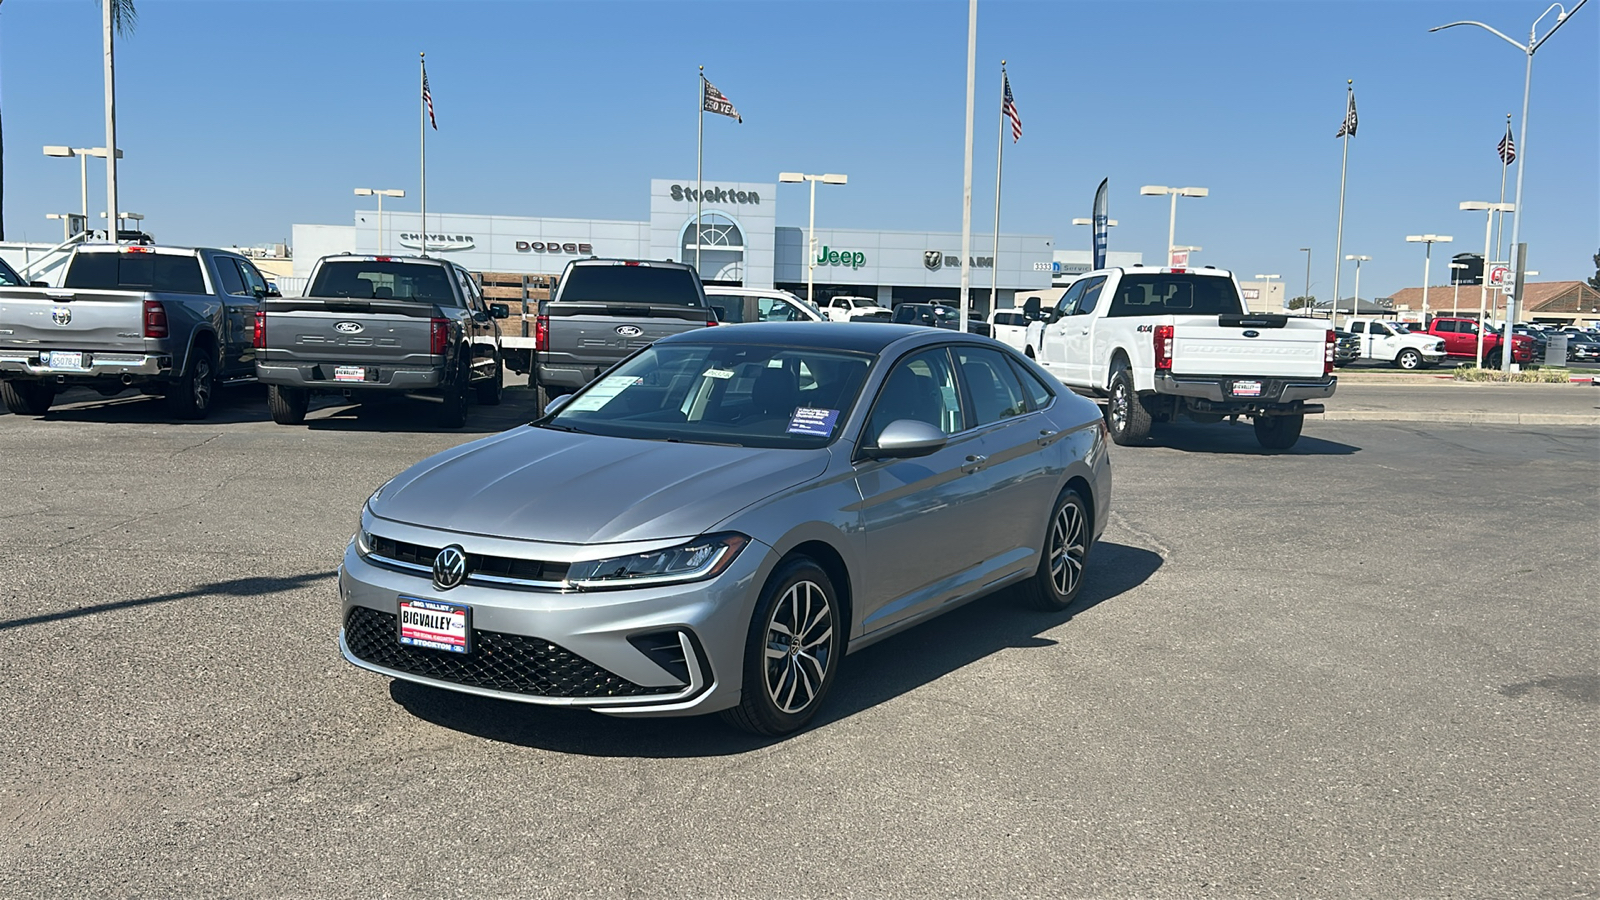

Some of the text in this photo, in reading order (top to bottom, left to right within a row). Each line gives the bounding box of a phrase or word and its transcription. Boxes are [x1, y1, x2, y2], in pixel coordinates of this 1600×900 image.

[670, 184, 760, 205] Stockton
[400, 233, 474, 243] CHRYSLER
[516, 241, 593, 255] DODGE
[817, 246, 865, 269] Jeep
[944, 255, 994, 268] RAM
[413, 600, 450, 611] BIG VALLEY
[402, 610, 452, 630] BIGVALLEY
[413, 639, 451, 650] STOCKTON
